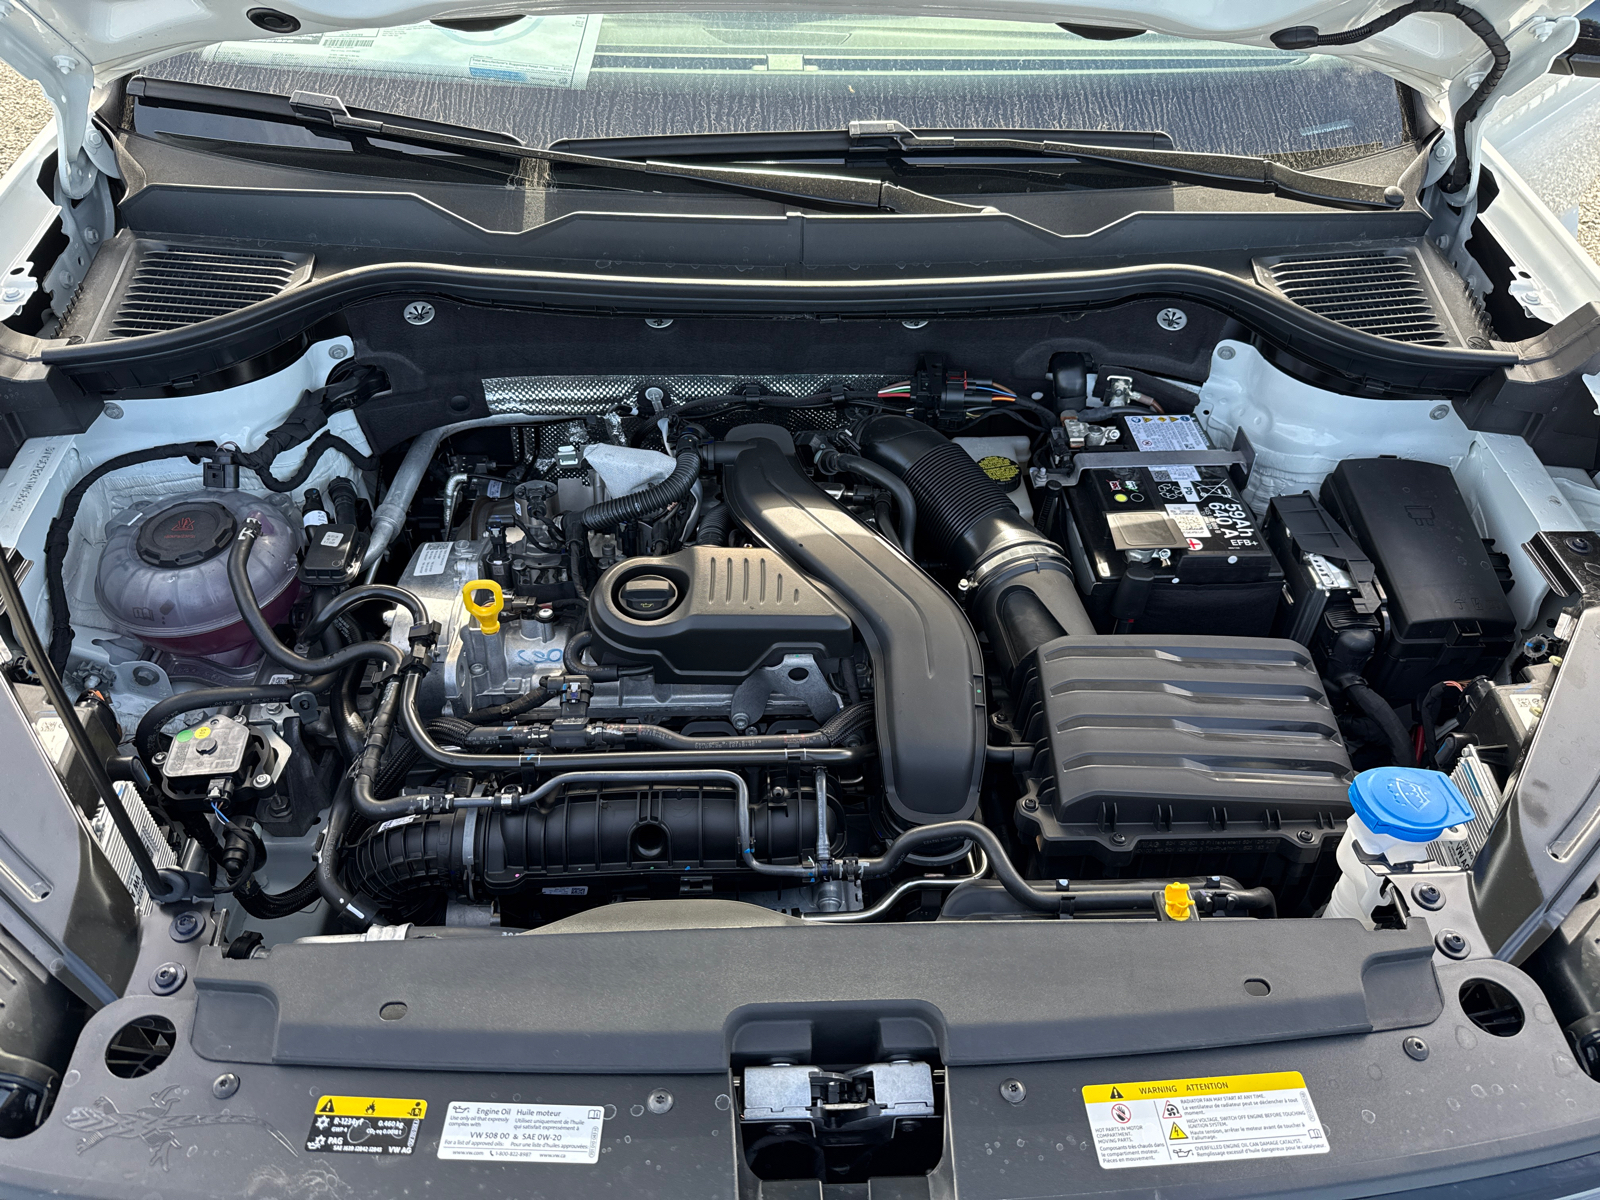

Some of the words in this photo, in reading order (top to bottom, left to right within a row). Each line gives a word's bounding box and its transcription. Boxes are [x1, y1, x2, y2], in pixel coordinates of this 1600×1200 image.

[1208, 502, 1234, 525] 640
[1225, 503, 1255, 537] 59Ah
[1220, 528, 1240, 538] A
[1456, 842, 1464, 858] VW
[1139, 1085, 1177, 1094] WARNING
[1186, 1082, 1229, 1091] ATTENTION
[477, 1108, 500, 1116] Engine
[334, 1117, 364, 1128] R-1234yf
[388, 1146, 400, 1154] VW
